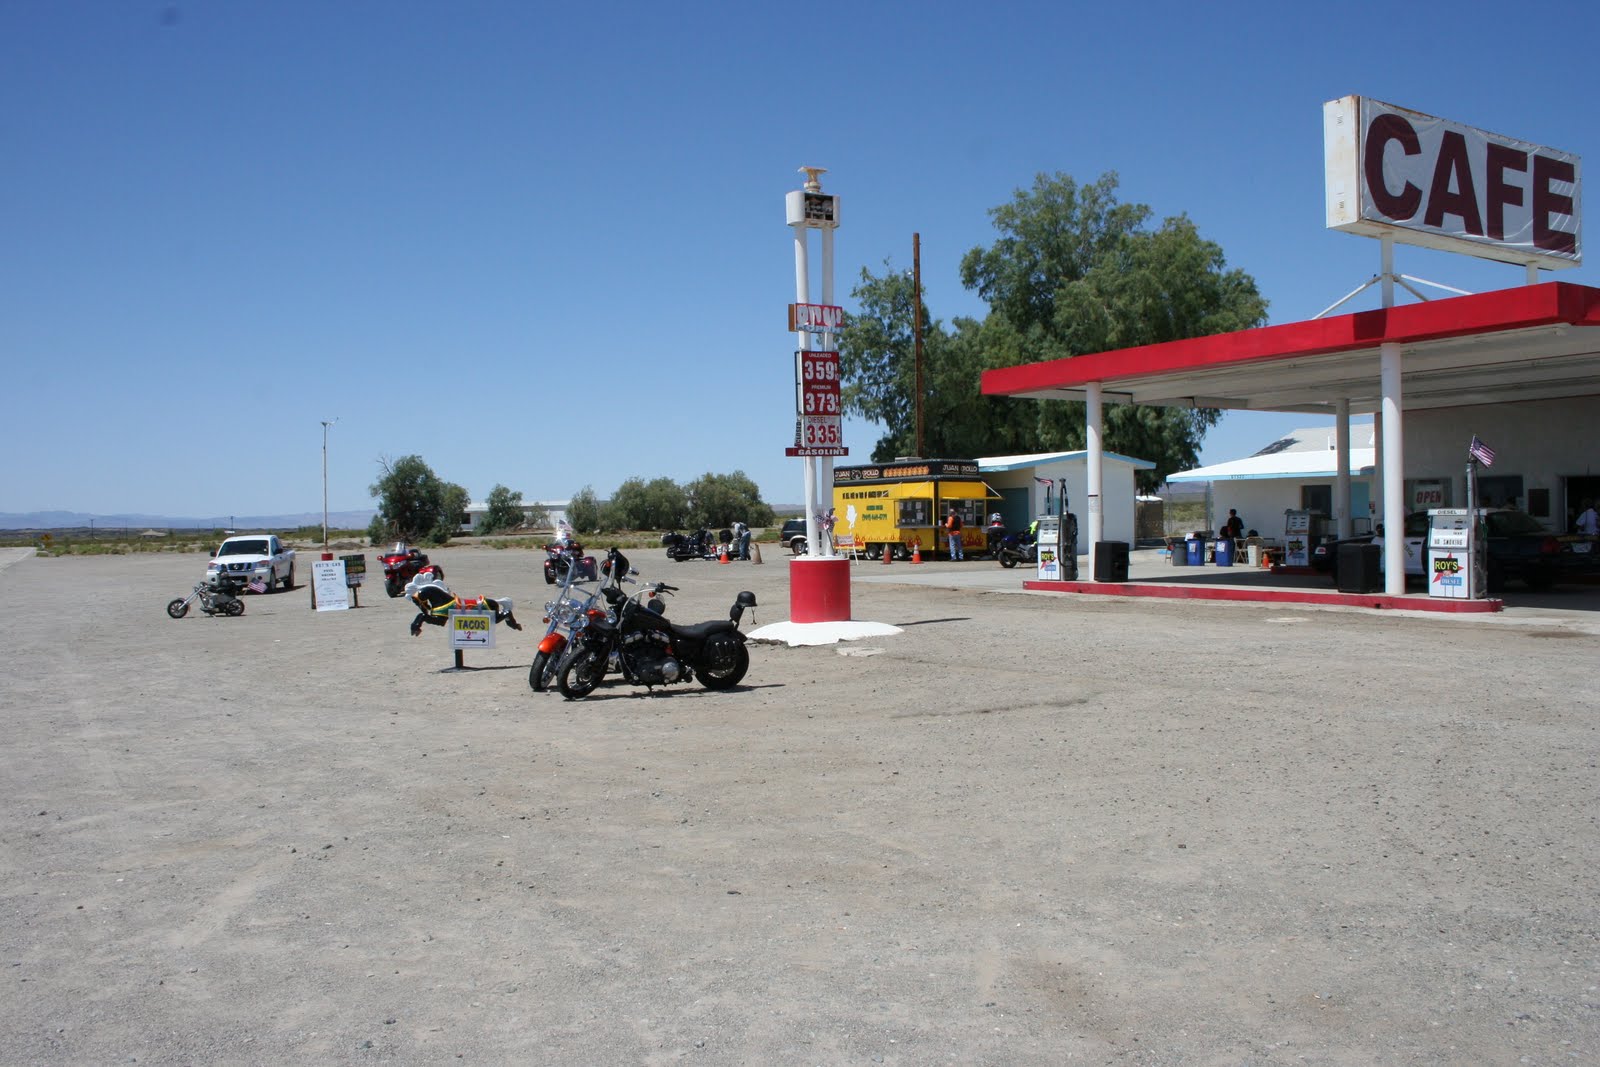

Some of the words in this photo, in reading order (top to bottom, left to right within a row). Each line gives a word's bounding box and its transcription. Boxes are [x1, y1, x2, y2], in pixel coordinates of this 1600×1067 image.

[1365, 113, 1576, 254] CAFE
[834, 470, 850, 478] JUAN
[862, 469, 880, 477] POLLO
[943, 464, 959, 472] JUAN
[961, 465, 978, 473] POLLO
[1416, 491, 1441, 504] OPEN
[1434, 560, 1458, 570] ROY'S
[457, 619, 486, 630] TACOS
